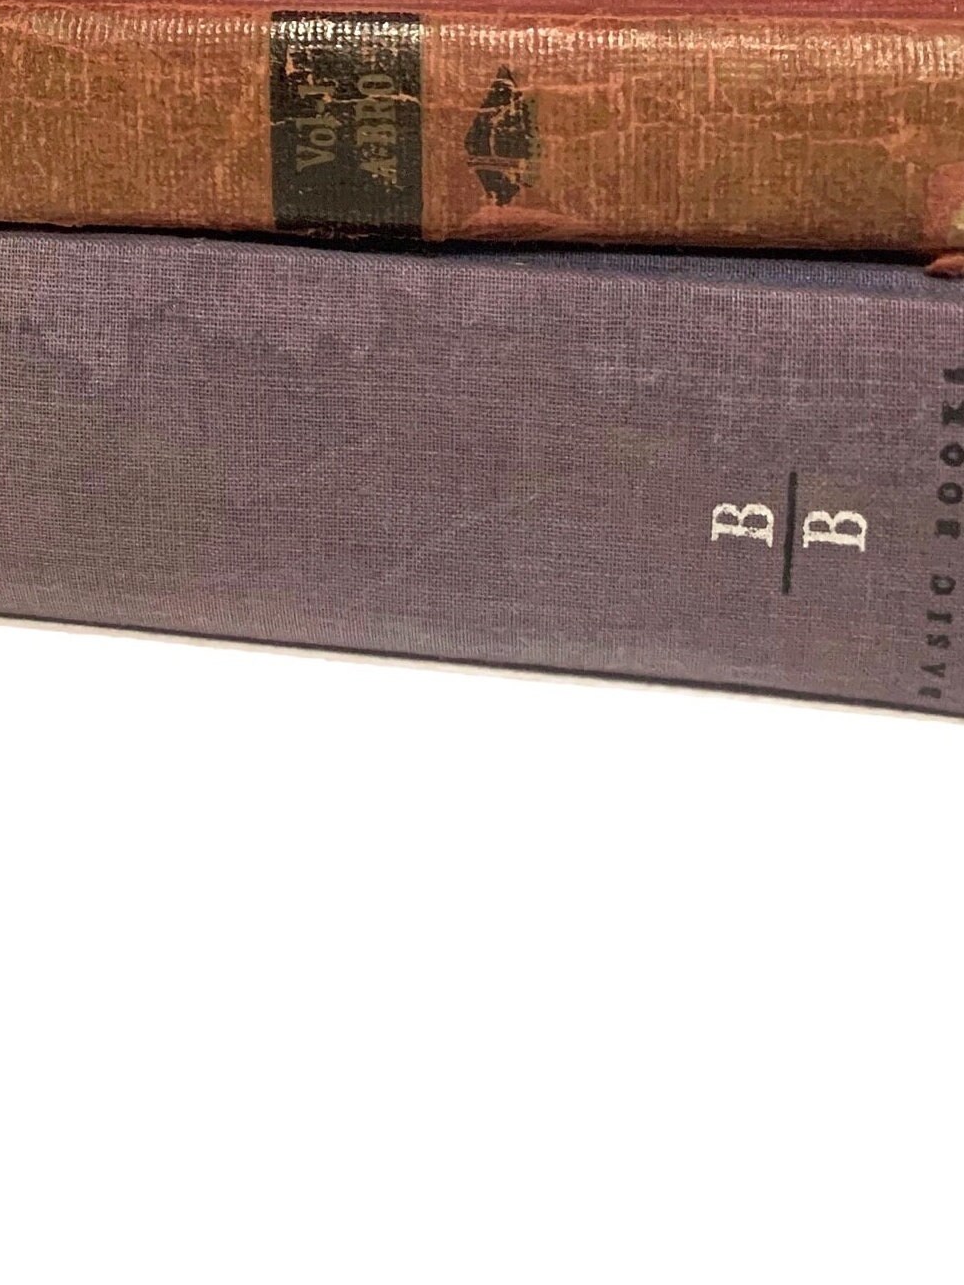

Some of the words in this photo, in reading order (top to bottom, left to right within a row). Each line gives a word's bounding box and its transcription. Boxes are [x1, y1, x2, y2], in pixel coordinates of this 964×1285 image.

[711, 502, 774, 548] B
[802, 510, 868, 552] B
[918, 573, 957, 700] BASIC
